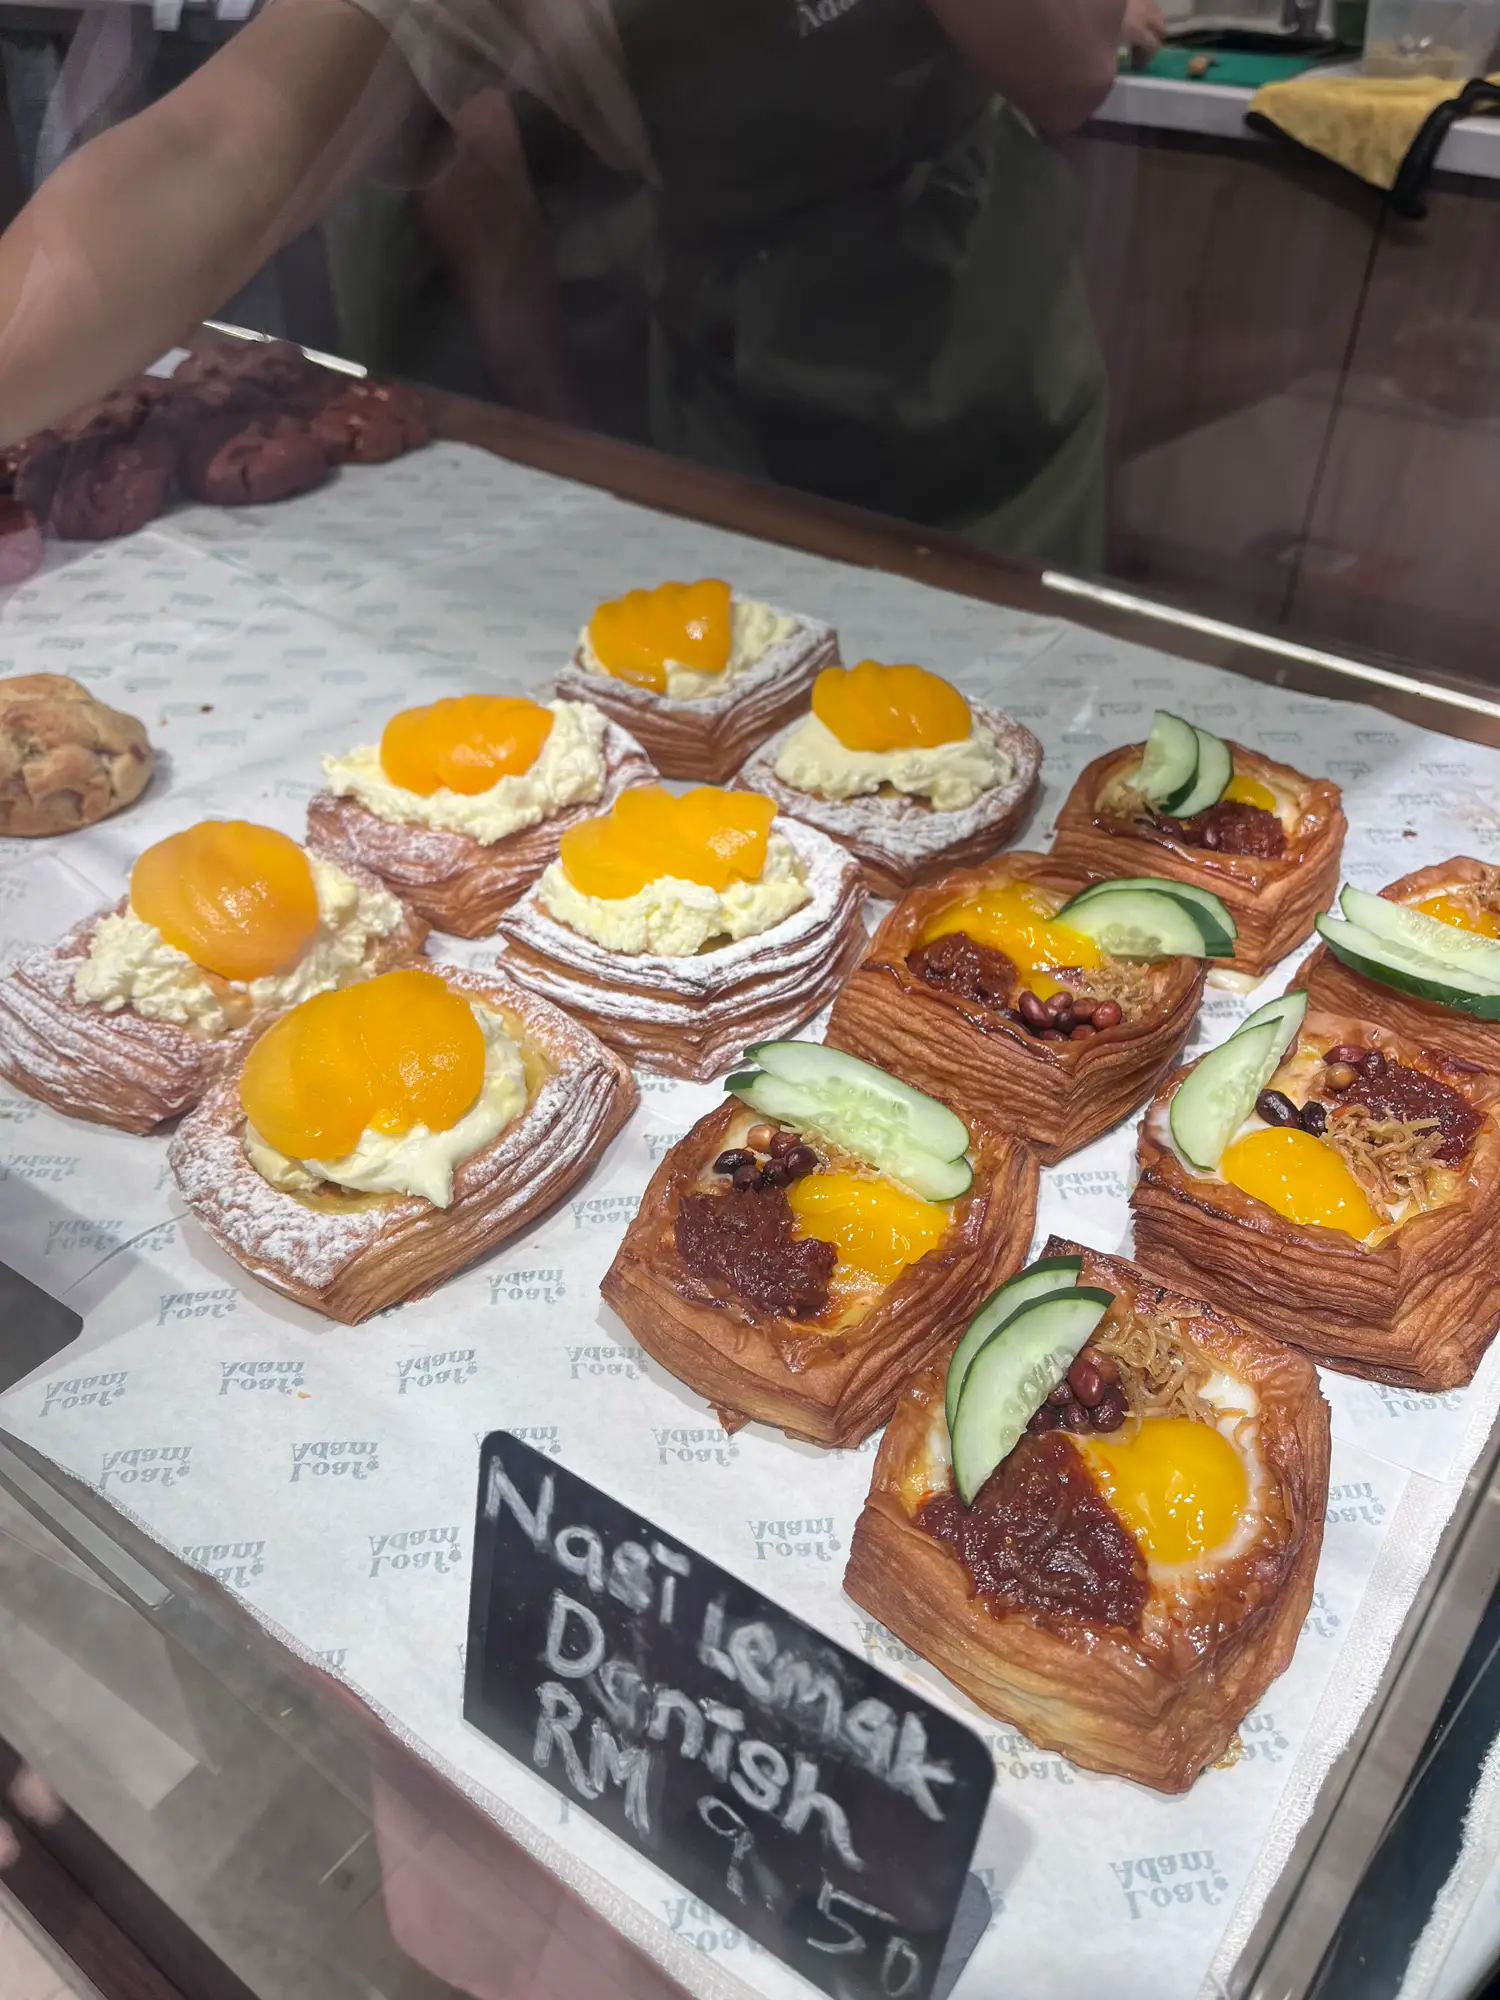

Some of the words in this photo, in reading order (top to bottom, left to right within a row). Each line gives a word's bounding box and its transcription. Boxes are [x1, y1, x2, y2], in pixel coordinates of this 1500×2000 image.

[484, 1455, 691, 1623] Nasi
[533, 1680, 651, 1837] RM
[547, 1588, 866, 1871] Danish
